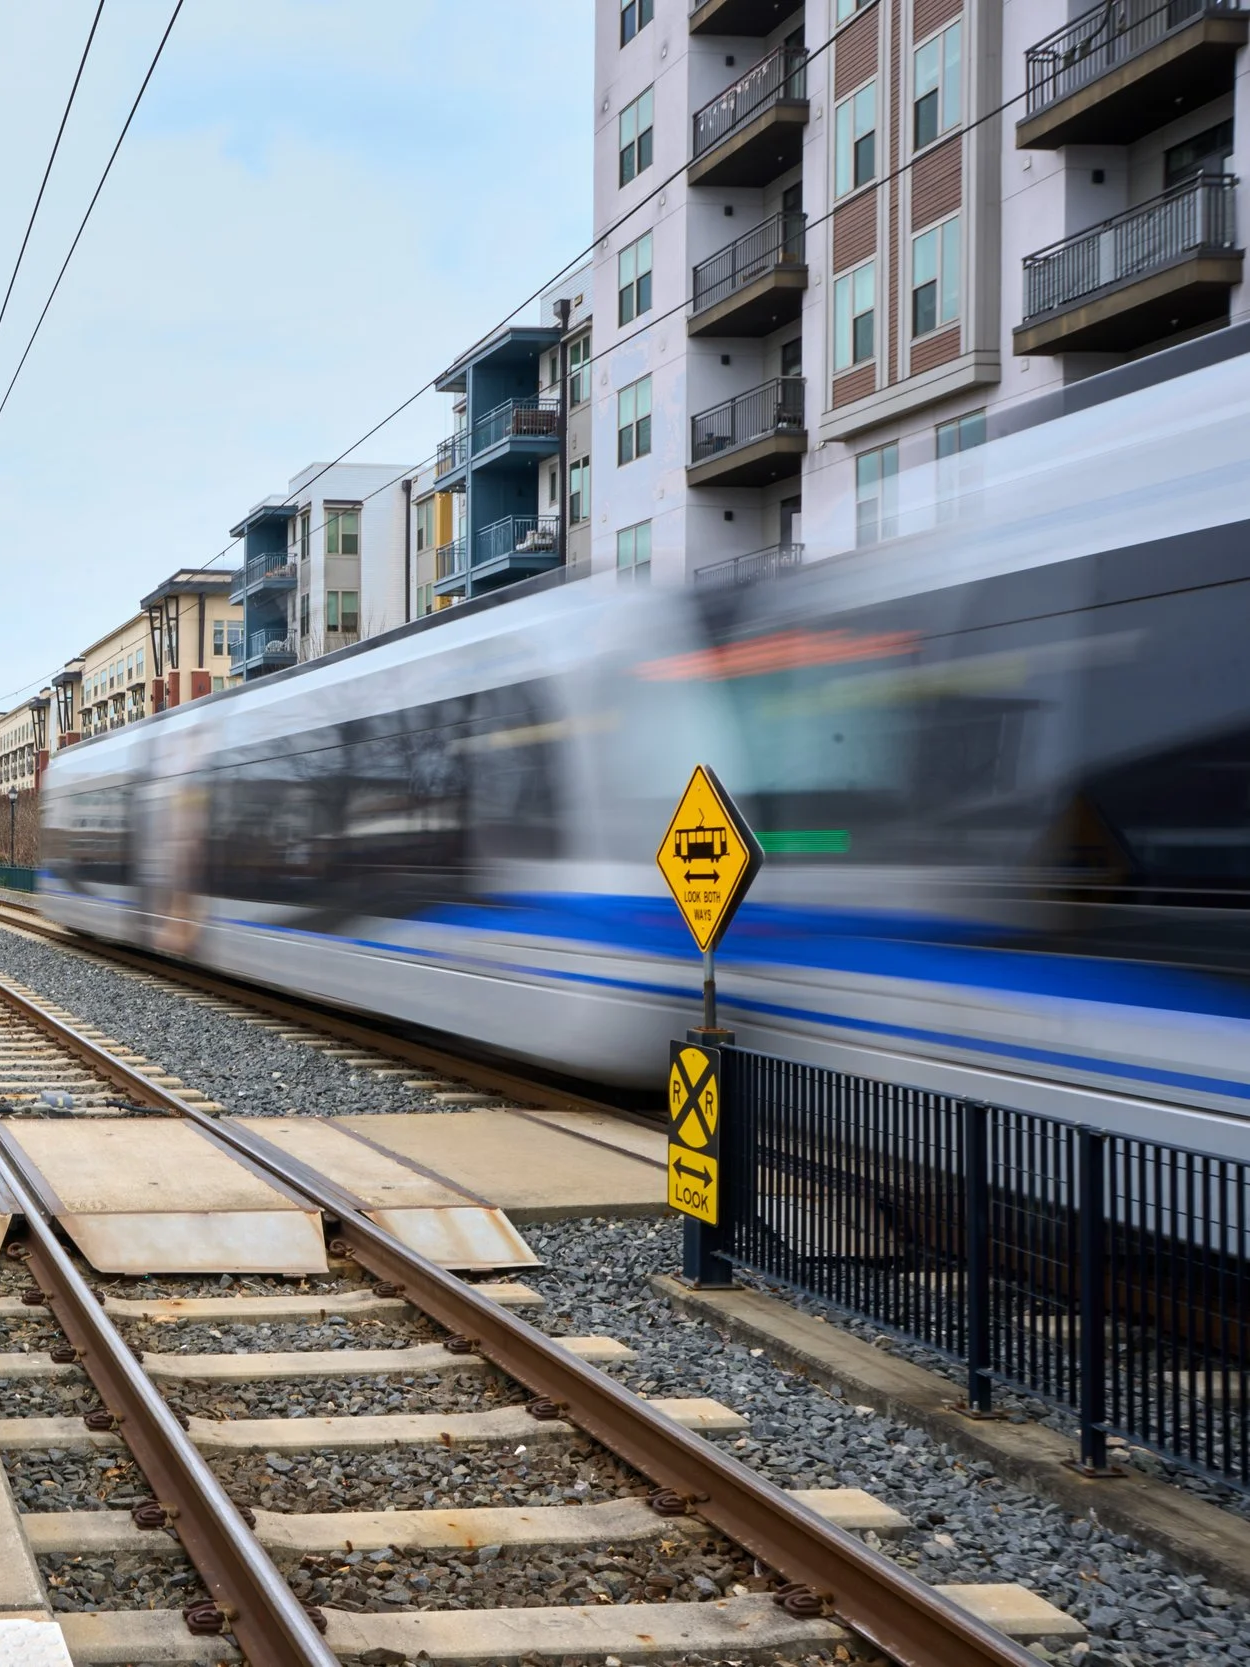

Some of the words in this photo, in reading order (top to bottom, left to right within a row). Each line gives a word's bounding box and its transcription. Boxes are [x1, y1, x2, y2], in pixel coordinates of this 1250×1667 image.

[684, 891, 701, 903] LOOK
[704, 891, 721, 903] BOTH
[693, 908, 712, 921] WAYS
[673, 1080, 681, 1105] R
[705, 1090, 714, 1116] R
[675, 1183, 709, 1214] LOOK
